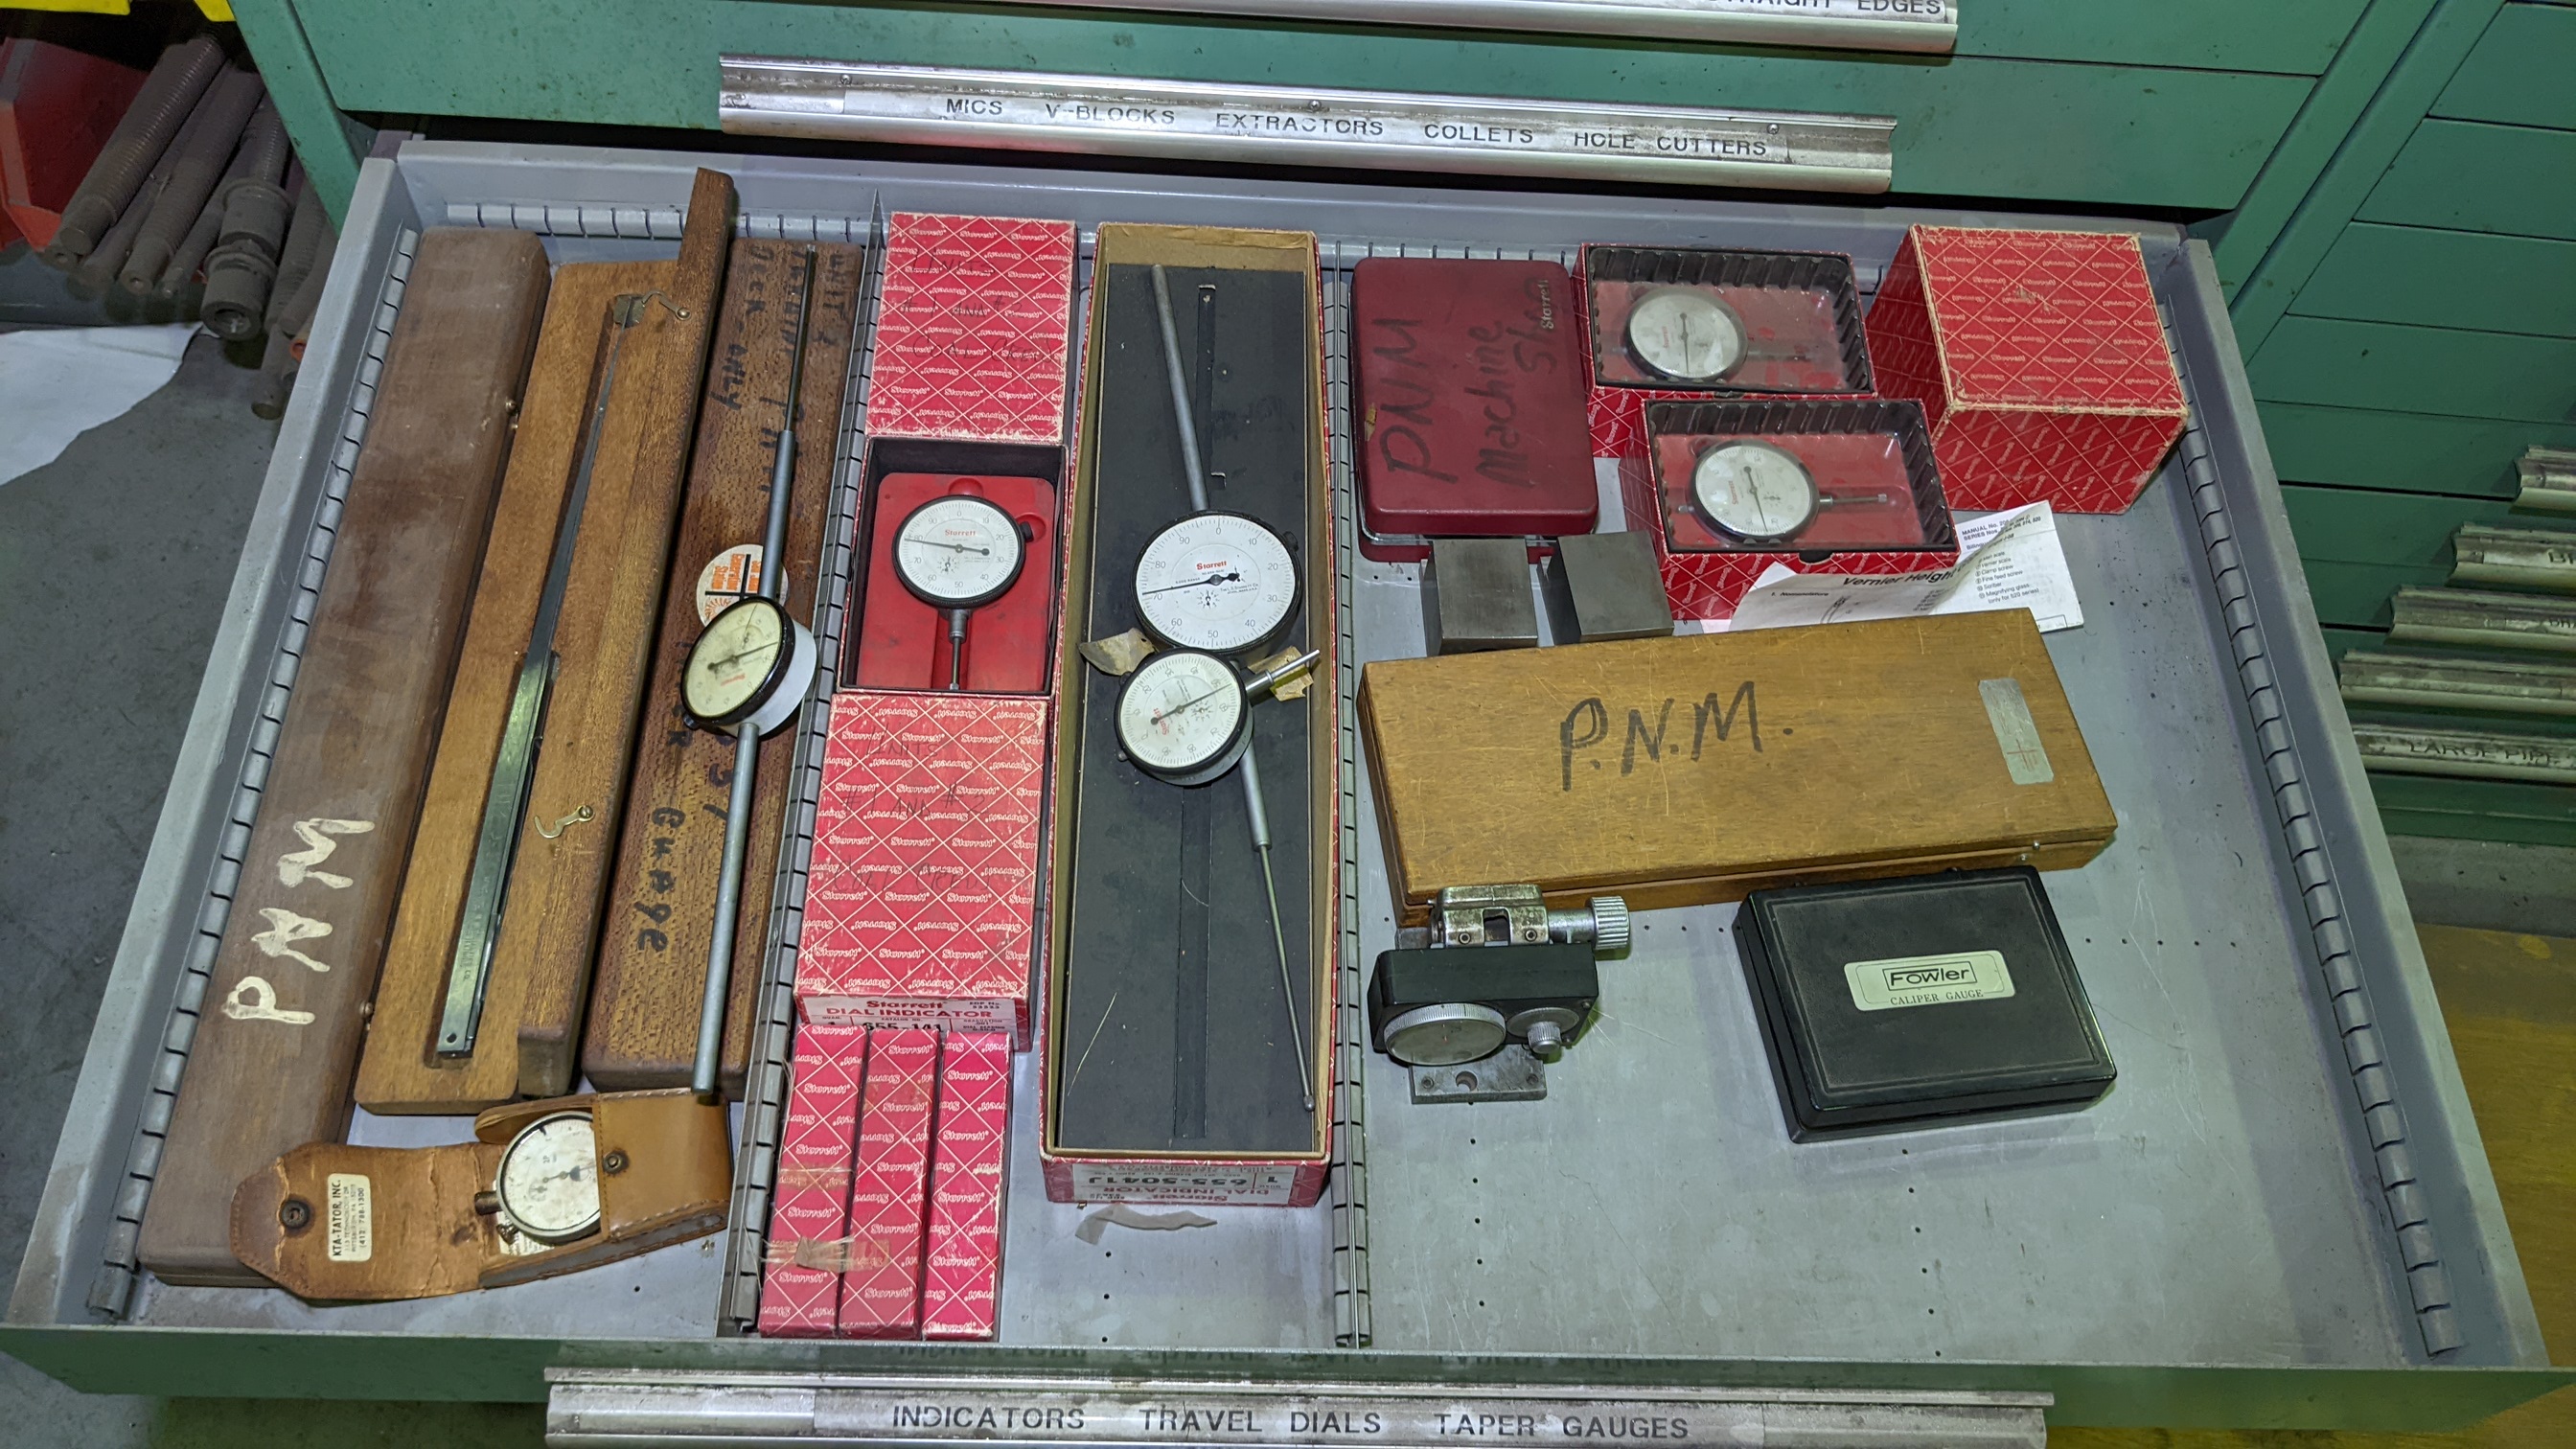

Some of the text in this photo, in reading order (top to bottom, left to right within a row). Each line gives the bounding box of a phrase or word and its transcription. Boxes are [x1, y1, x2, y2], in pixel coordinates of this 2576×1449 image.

[945, 98, 1767, 156] MICS V-BLOCKS EXTRACTORS COLLETS HOLE CUTTERS
[1962, 525, 1988, 536] MANUAL
[1179, 537, 1190, 545] 90
[1195, 561, 1228, 570] Starrett
[1843, 575, 1903, 586] Vernier
[1153, 592, 1163, 601] 70
[1266, 594, 1278, 603] 30
[1171, 617, 1183, 627] 60
[1245, 619, 1255, 628] 40
[1208, 630, 1219, 638] 50
[1890, 967, 1970, 986] Fowler
[1890, 989, 1985, 1006] CALIPER GAUGE
[866, 1000, 943, 1009] Starrett
[879, 1009, 993, 1018] INDICATOR
[332, 1180, 341, 1199] INC.
[1103, 1186, 1215, 1195] INDICATOR
[892, 1405, 1690, 1439] INDICATORS TRAVEL DIALS TAPER GAUGES
